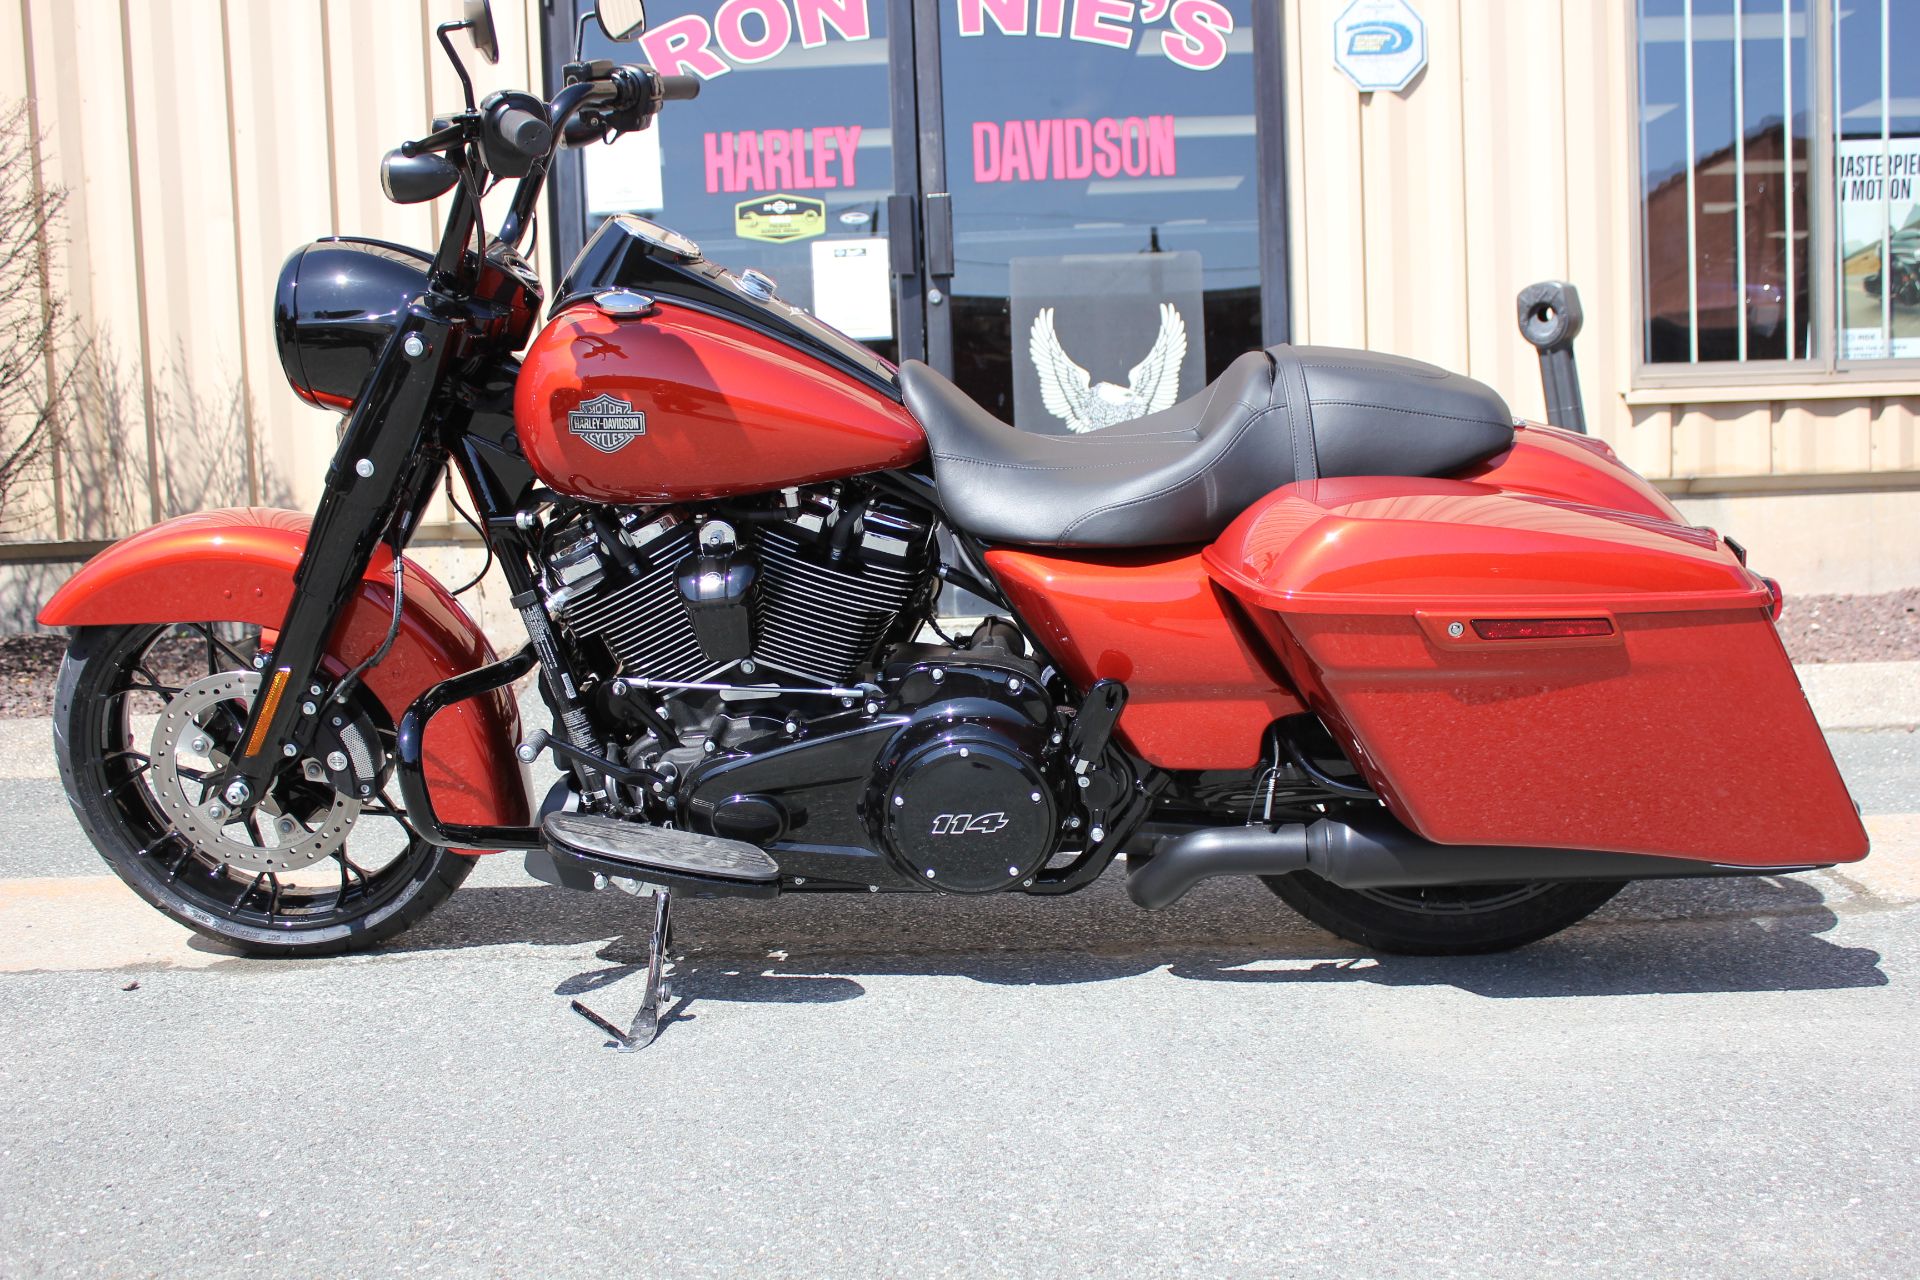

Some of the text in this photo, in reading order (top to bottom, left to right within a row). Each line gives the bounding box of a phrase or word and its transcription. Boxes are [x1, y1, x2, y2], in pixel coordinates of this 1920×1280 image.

[704, 114, 1176, 194] HARLEY DAVIDSON
[588, 400, 623, 414] MOTOR
[574, 416, 639, 430] HARLEY-DAVIDSON
[589, 432, 625, 448] CYCLES
[931, 812, 1010, 835] 114
